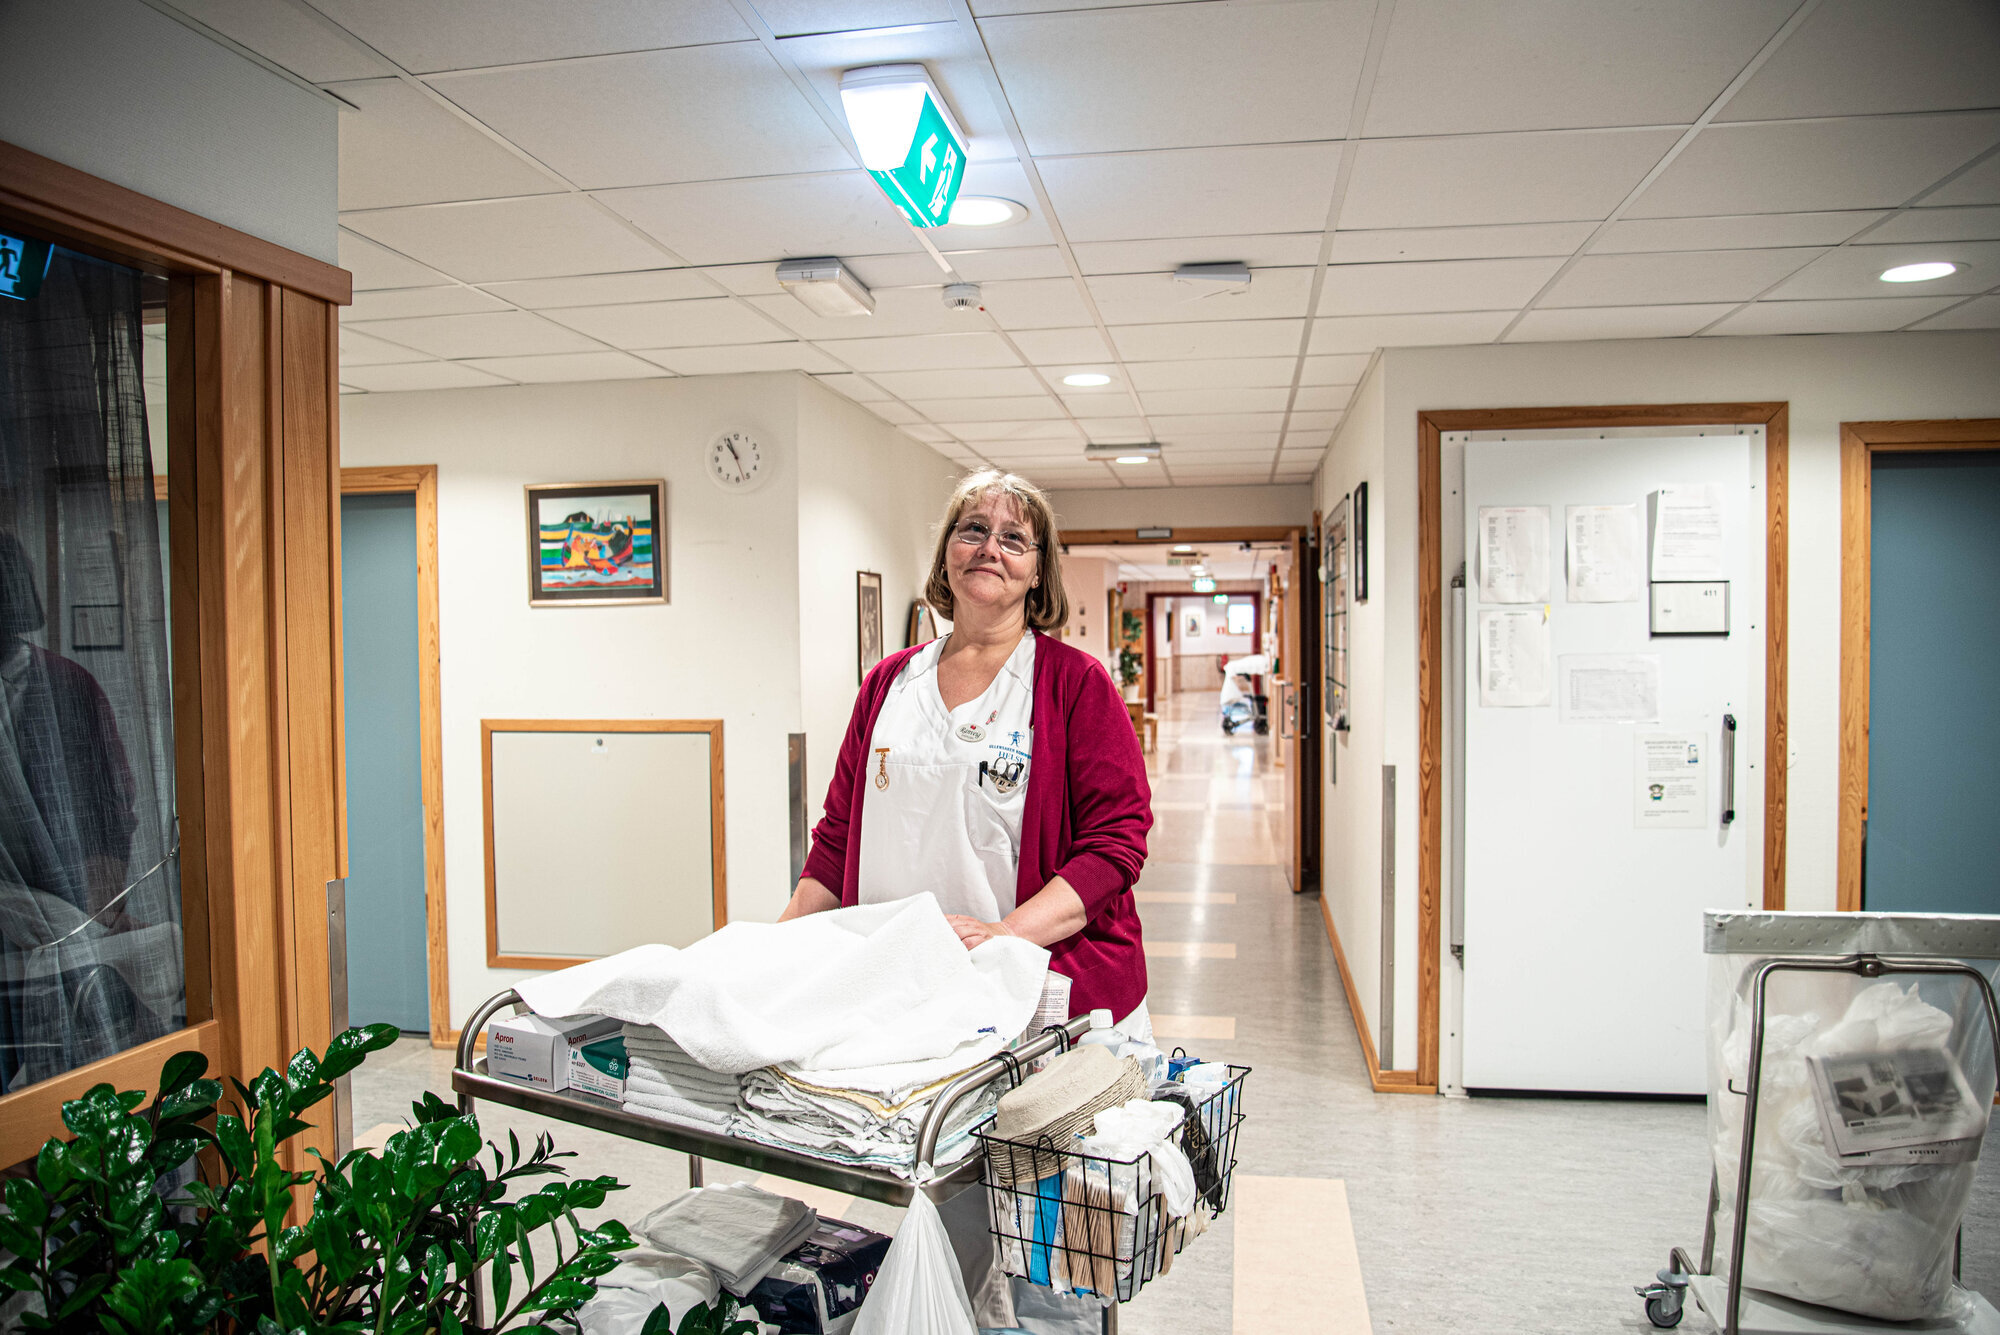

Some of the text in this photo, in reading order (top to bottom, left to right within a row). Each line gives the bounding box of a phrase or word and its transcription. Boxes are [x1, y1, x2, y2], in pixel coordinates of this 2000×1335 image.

[733, 433, 740, 441] 12
[752, 442, 757, 450] 2
[714, 455, 720, 463] 9
[755, 453, 760, 461] 3
[717, 466, 723, 474] 8
[745, 472, 751, 480] 5
[1703, 589, 1717, 597] 411
[494, 1032, 514, 1044] Apron
[568, 1034, 587, 1046] Apron
[571, 1050, 578, 1060] M
[604, 1090, 619, 1099] GLOVES
